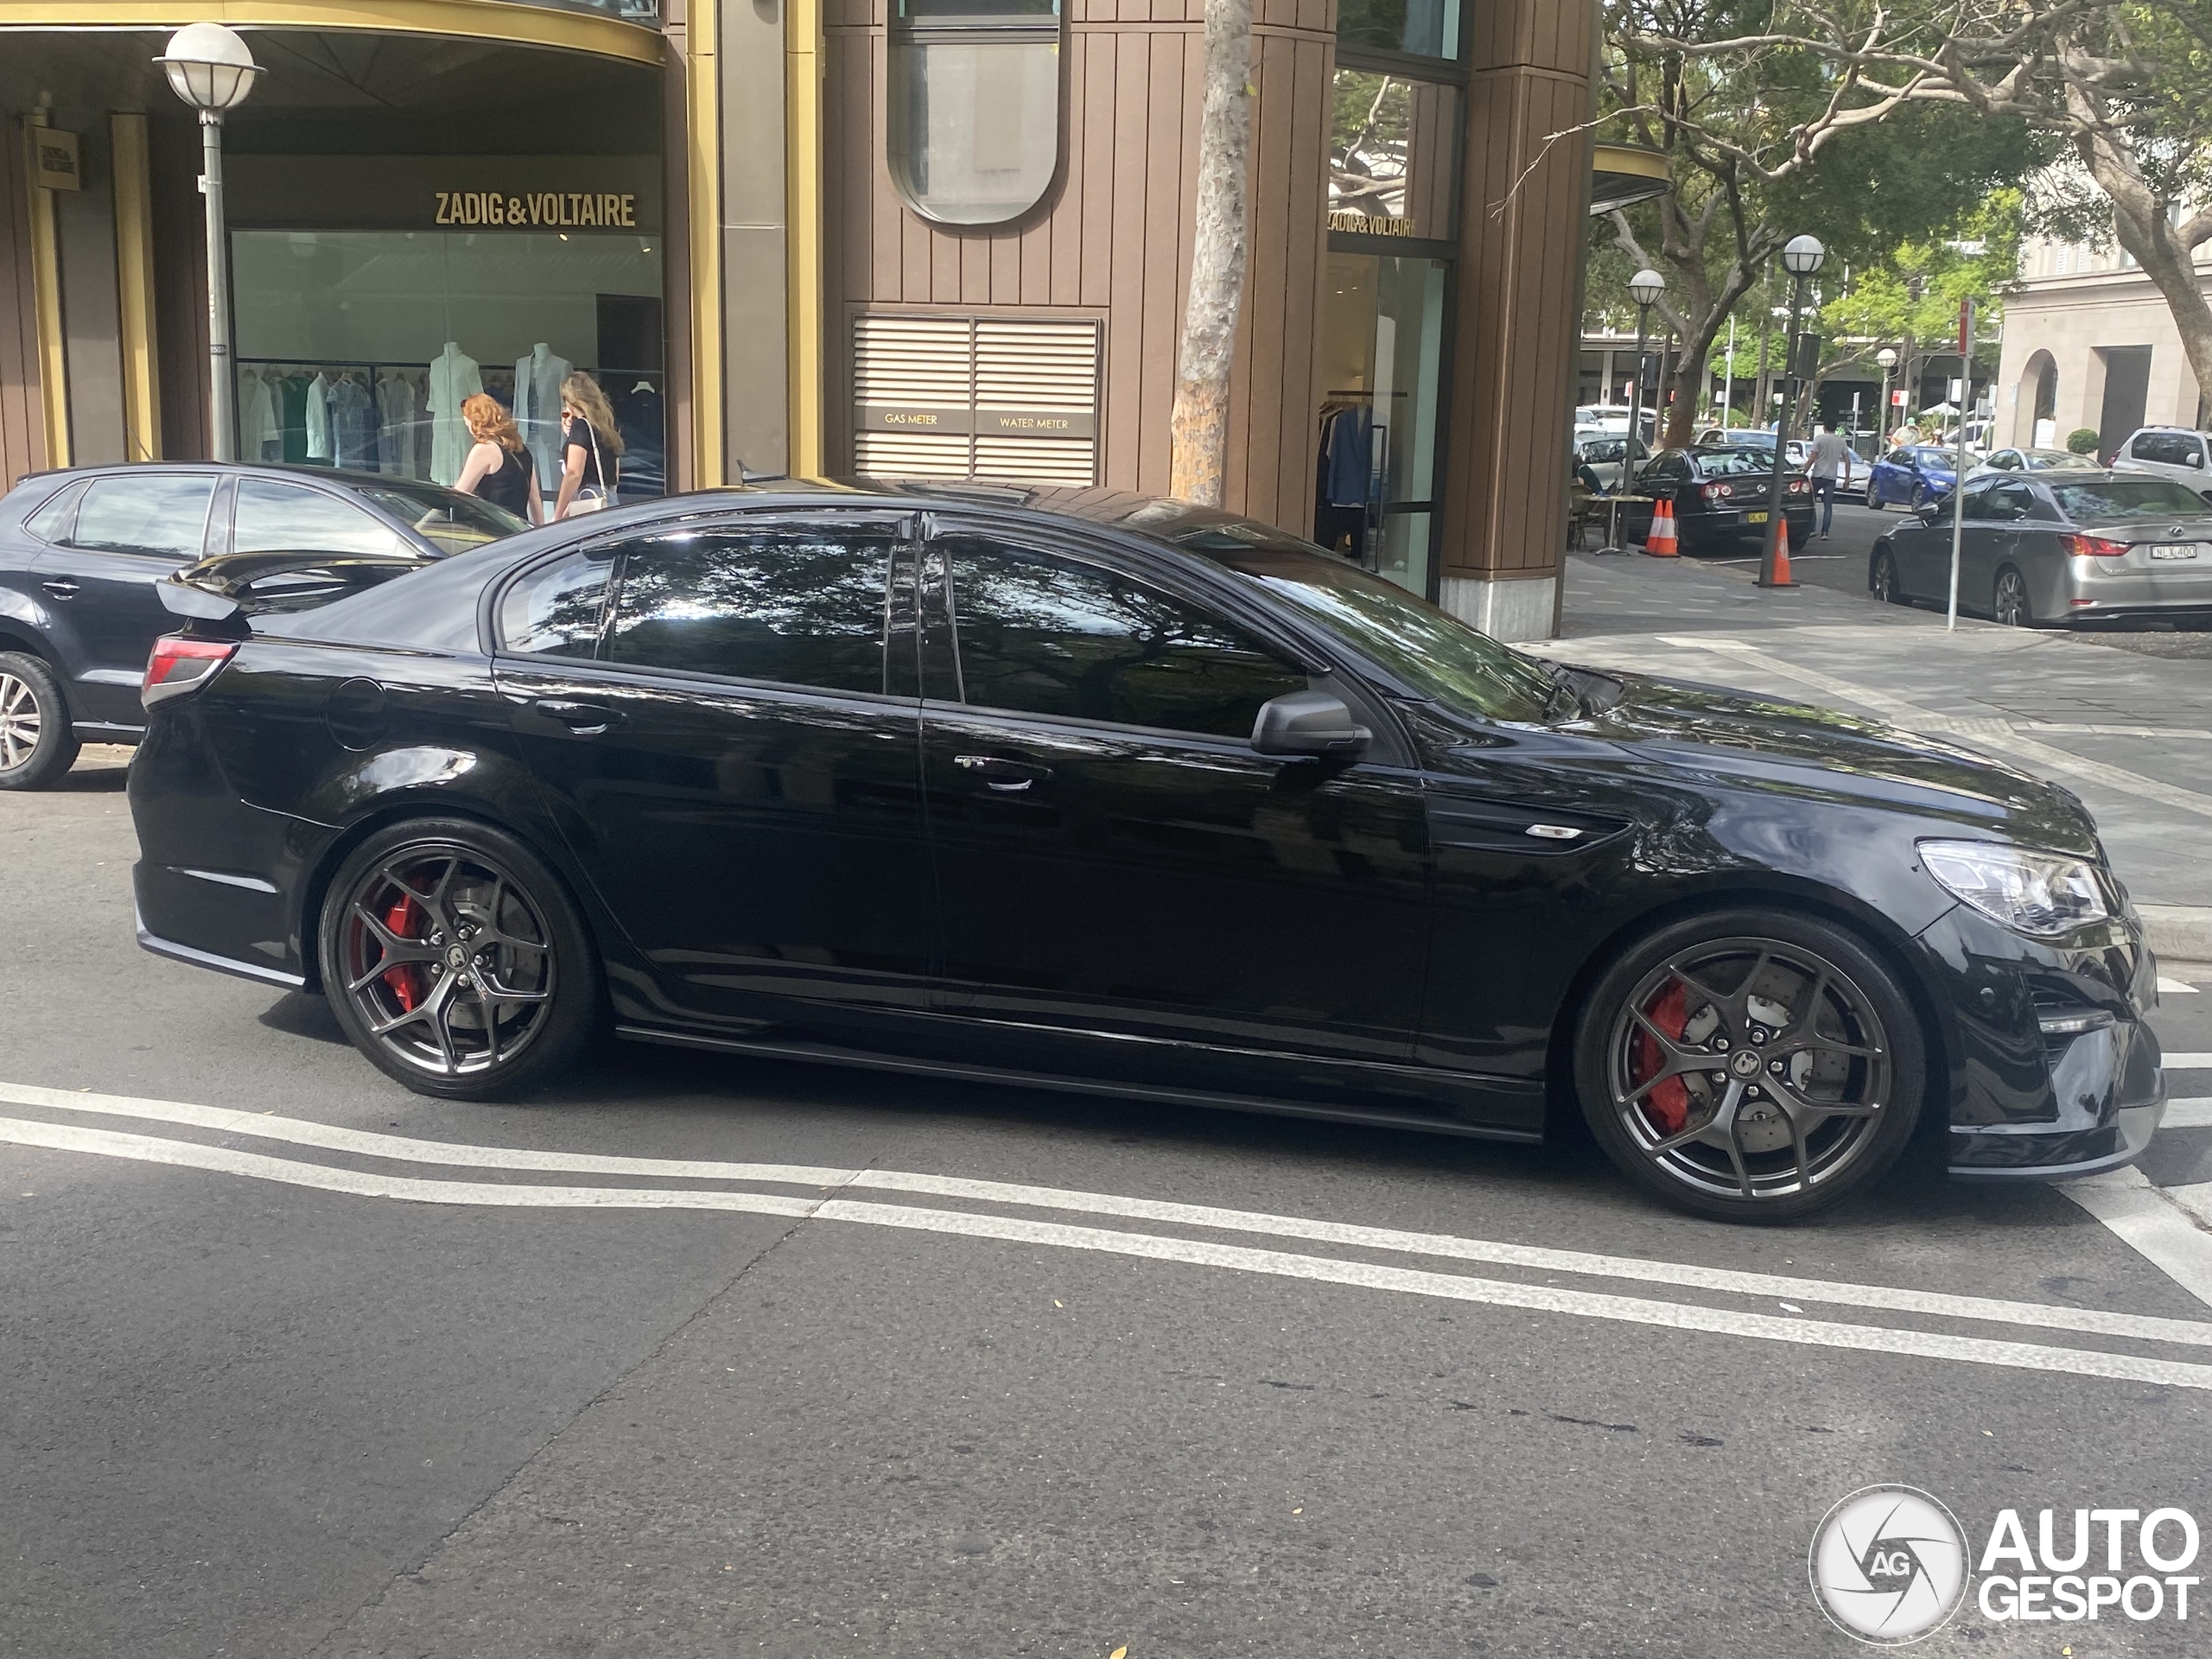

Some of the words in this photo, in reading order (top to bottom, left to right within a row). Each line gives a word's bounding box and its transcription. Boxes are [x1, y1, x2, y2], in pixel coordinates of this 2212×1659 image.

[435, 193, 636, 226] ZADIG&VOLTAIRE
[884, 413, 906, 424] GAS
[907, 414, 938, 425] METER
[1000, 417, 1034, 429] WATER
[1036, 419, 1068, 429] METER
